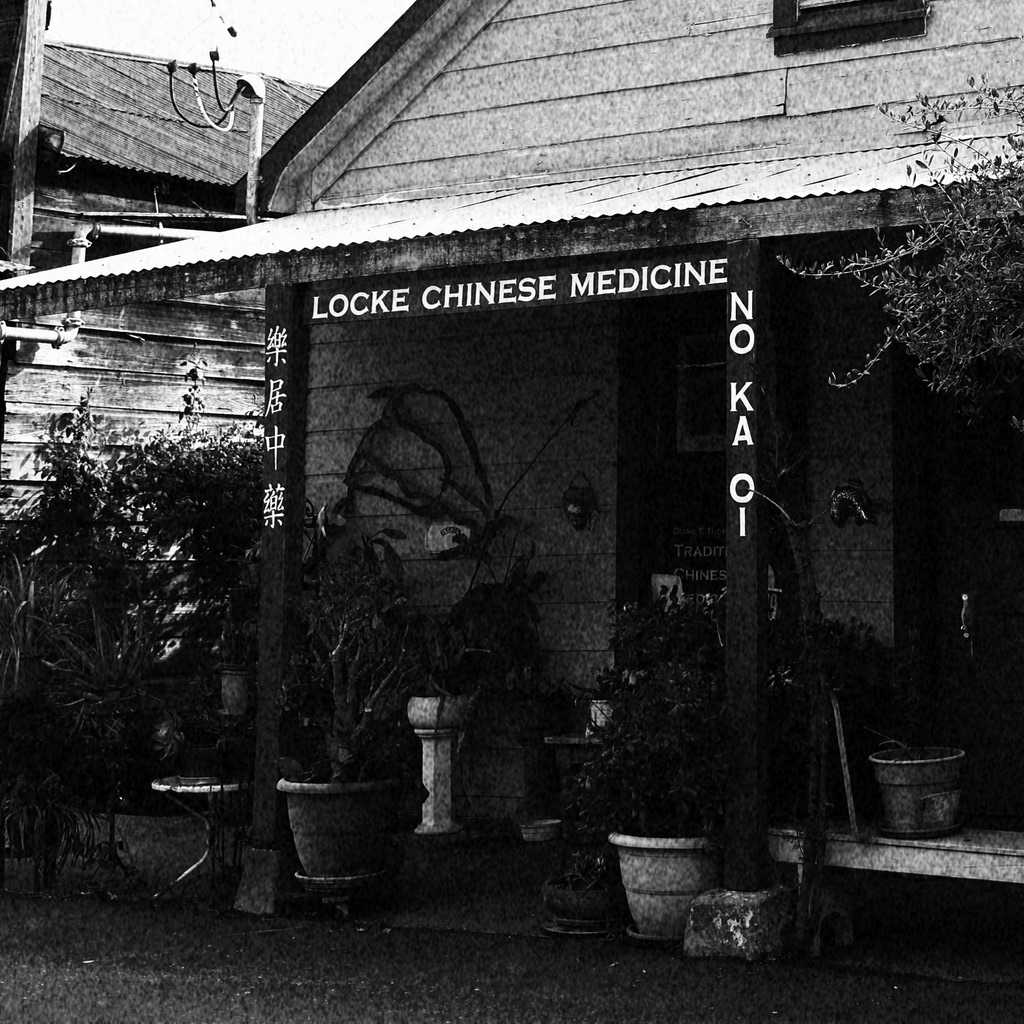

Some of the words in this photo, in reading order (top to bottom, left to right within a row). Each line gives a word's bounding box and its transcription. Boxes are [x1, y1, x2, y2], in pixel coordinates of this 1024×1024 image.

[311, 286, 410, 320] LOCKE
[421, 274, 557, 310] CHINESE
[569, 257, 728, 298] MEDICINE
[729, 289, 755, 355] NO
[729, 381, 755, 446] KA
